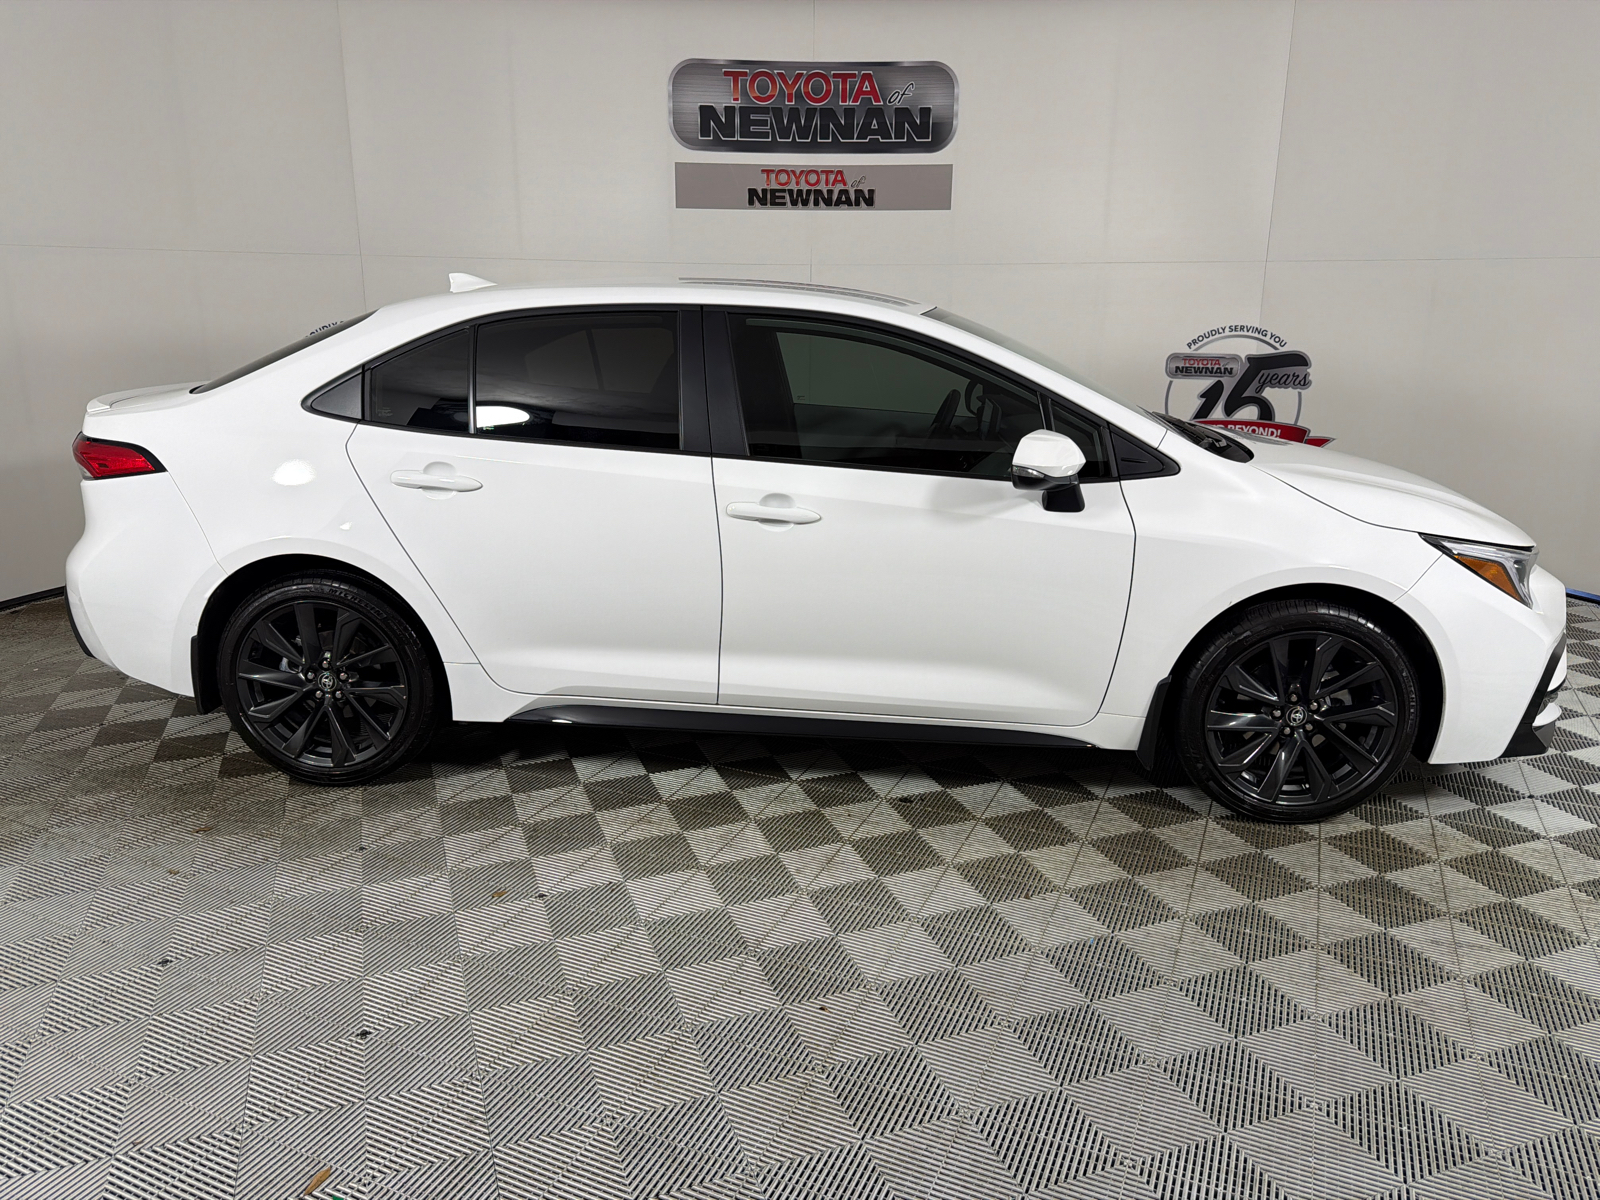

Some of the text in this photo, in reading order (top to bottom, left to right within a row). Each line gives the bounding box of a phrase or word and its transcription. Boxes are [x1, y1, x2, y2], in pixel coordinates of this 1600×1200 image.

[723, 69, 914, 105] TOYOTA of
[698, 104, 932, 142] NEWNAN
[761, 169, 866, 188] TOYOTA of
[747, 188, 875, 207] NEWNAN
[1186, 325, 1288, 349] PROUDLY SERVING YOU
[1175, 366, 1233, 375] NEWNAN
[1182, 358, 1221, 366] TOYOTA
[1193, 353, 1309, 421] 15
[1255, 372, 1310, 394] years
[329, 588, 383, 617] MICHELIN
